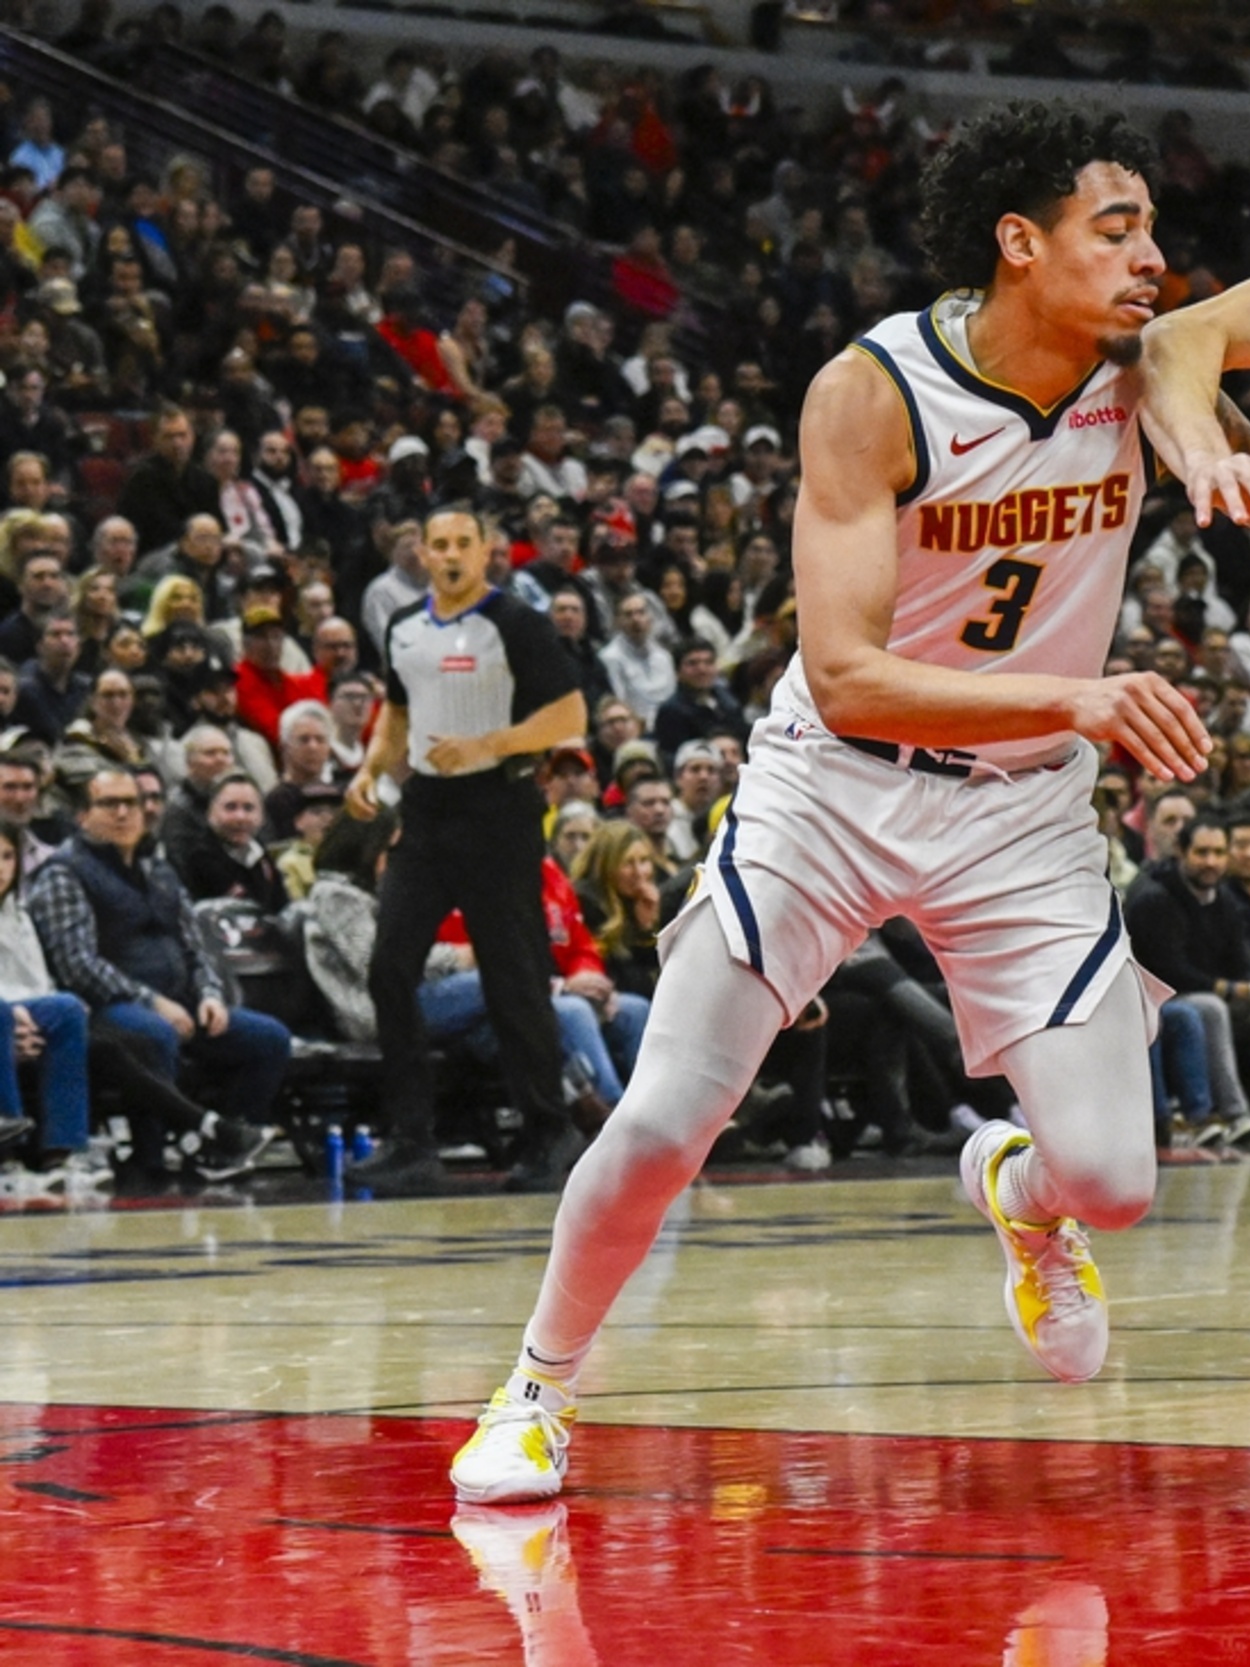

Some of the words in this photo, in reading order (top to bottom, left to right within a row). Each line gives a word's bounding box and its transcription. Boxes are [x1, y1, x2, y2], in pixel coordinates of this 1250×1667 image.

[1068, 406, 1127, 430] ibotta
[919, 472, 1132, 553] NUGGETS
[959, 555, 1046, 652] 3
